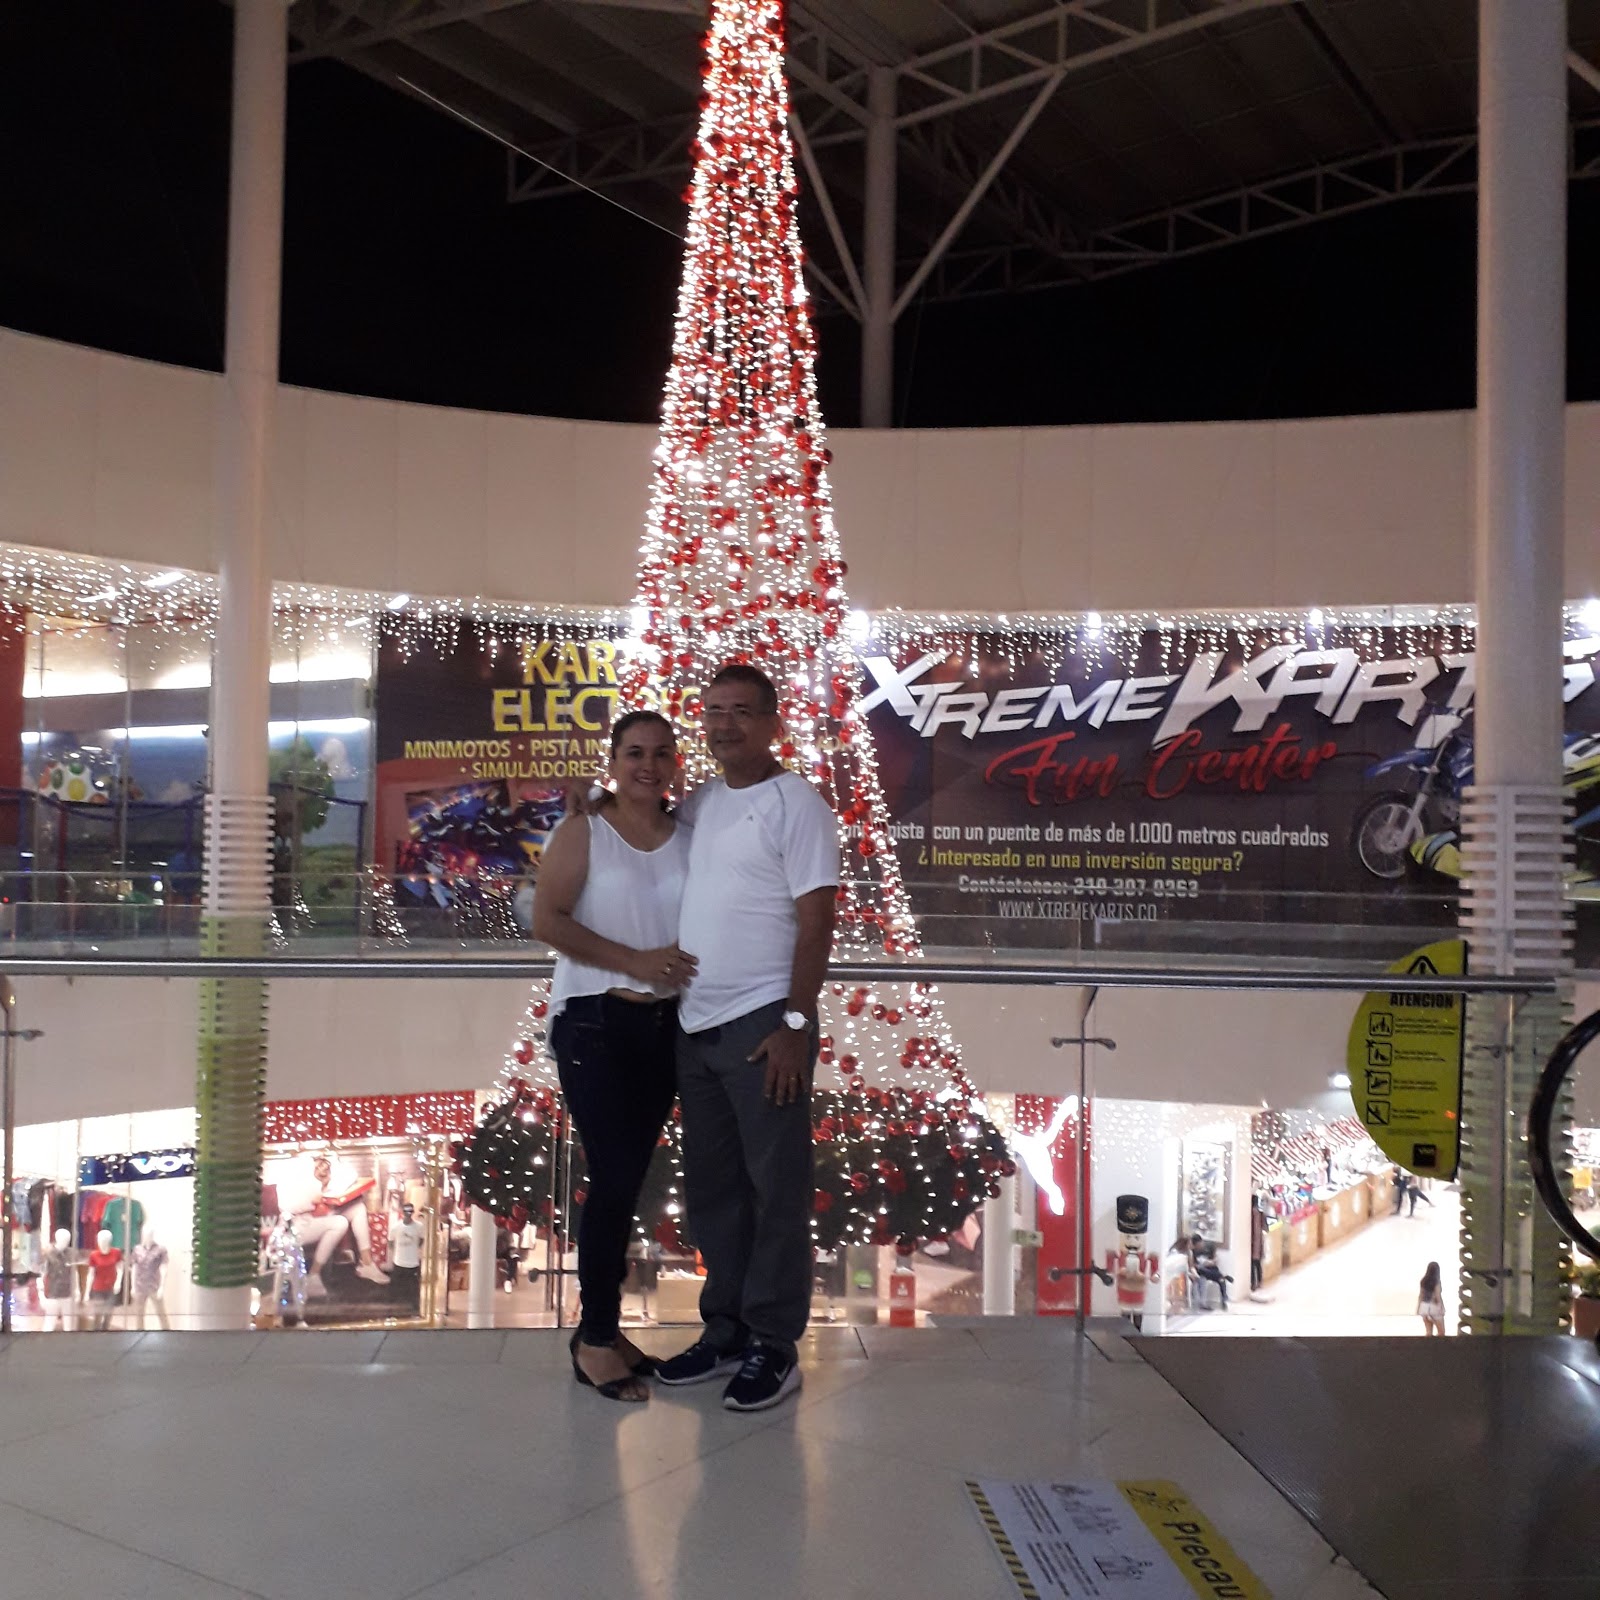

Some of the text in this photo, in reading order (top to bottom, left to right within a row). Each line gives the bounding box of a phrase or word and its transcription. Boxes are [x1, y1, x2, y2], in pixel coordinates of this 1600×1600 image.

[404, 740, 511, 759] MINIMOTOS
[531, 738, 582, 756] PISTA
[471, 759, 600, 779] SIMULADORES
[985, 722, 1338, 805] Fun Center
[933, 826, 960, 841] con
[965, 827, 984, 841] un
[988, 825, 1040, 845] puente
[1045, 821, 1064, 842] de
[1068, 823, 1101, 843] más
[1106, 821, 1126, 842] de
[1130, 823, 1172, 844] 1.000
[1177, 825, 1237, 845] metros
[1242, 823, 1329, 846] cuadrados
[1026, 852, 1046, 867] en
[1051, 854, 1080, 868] una
[1086, 851, 1166, 870] inversión
[1172, 851, 1243, 875] segura?
